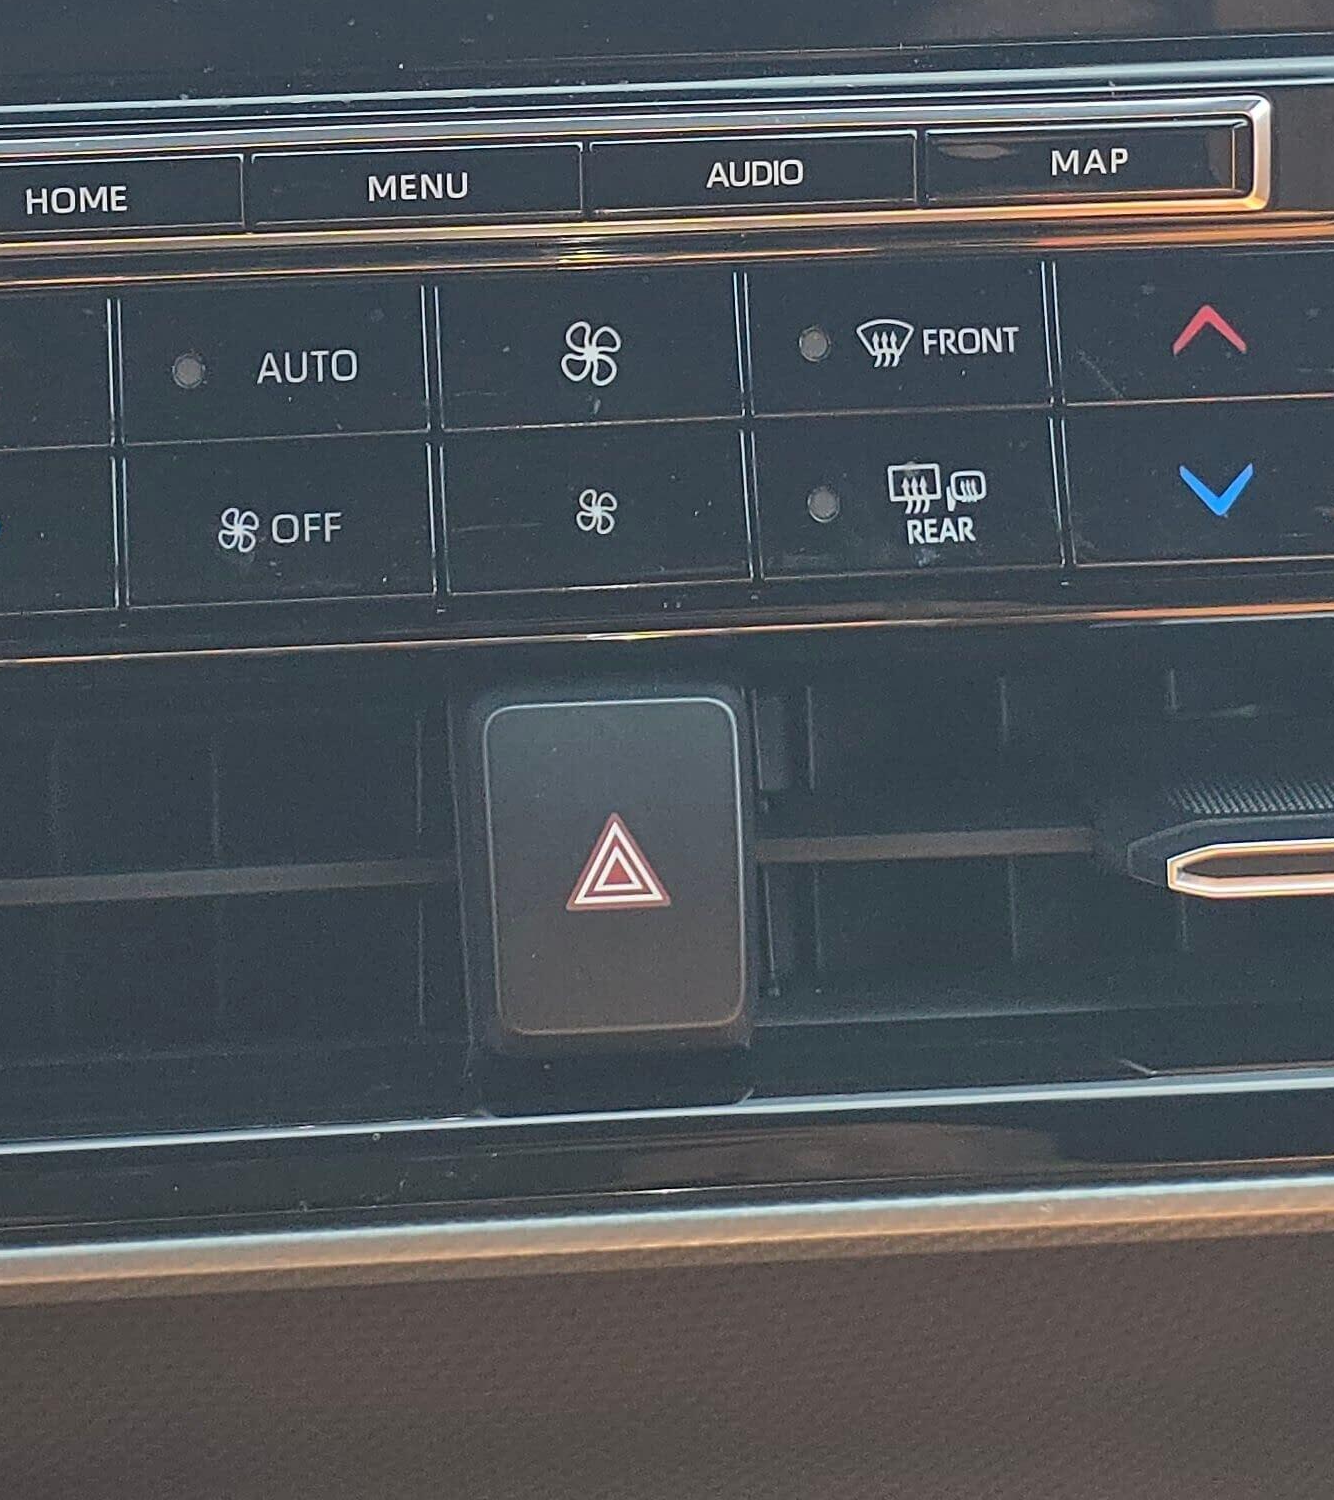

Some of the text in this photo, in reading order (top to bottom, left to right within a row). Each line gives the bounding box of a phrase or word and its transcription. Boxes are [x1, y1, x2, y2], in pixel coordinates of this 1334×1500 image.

[705, 158, 805, 189] AUDIO
[1050, 147, 1129, 177] MAP
[24, 184, 128, 216] HOME
[366, 170, 471, 203] MENU
[922, 326, 1019, 356] FRONT
[256, 348, 359, 384] AUTO
[271, 511, 343, 545] OFF
[906, 516, 977, 545] REAR
